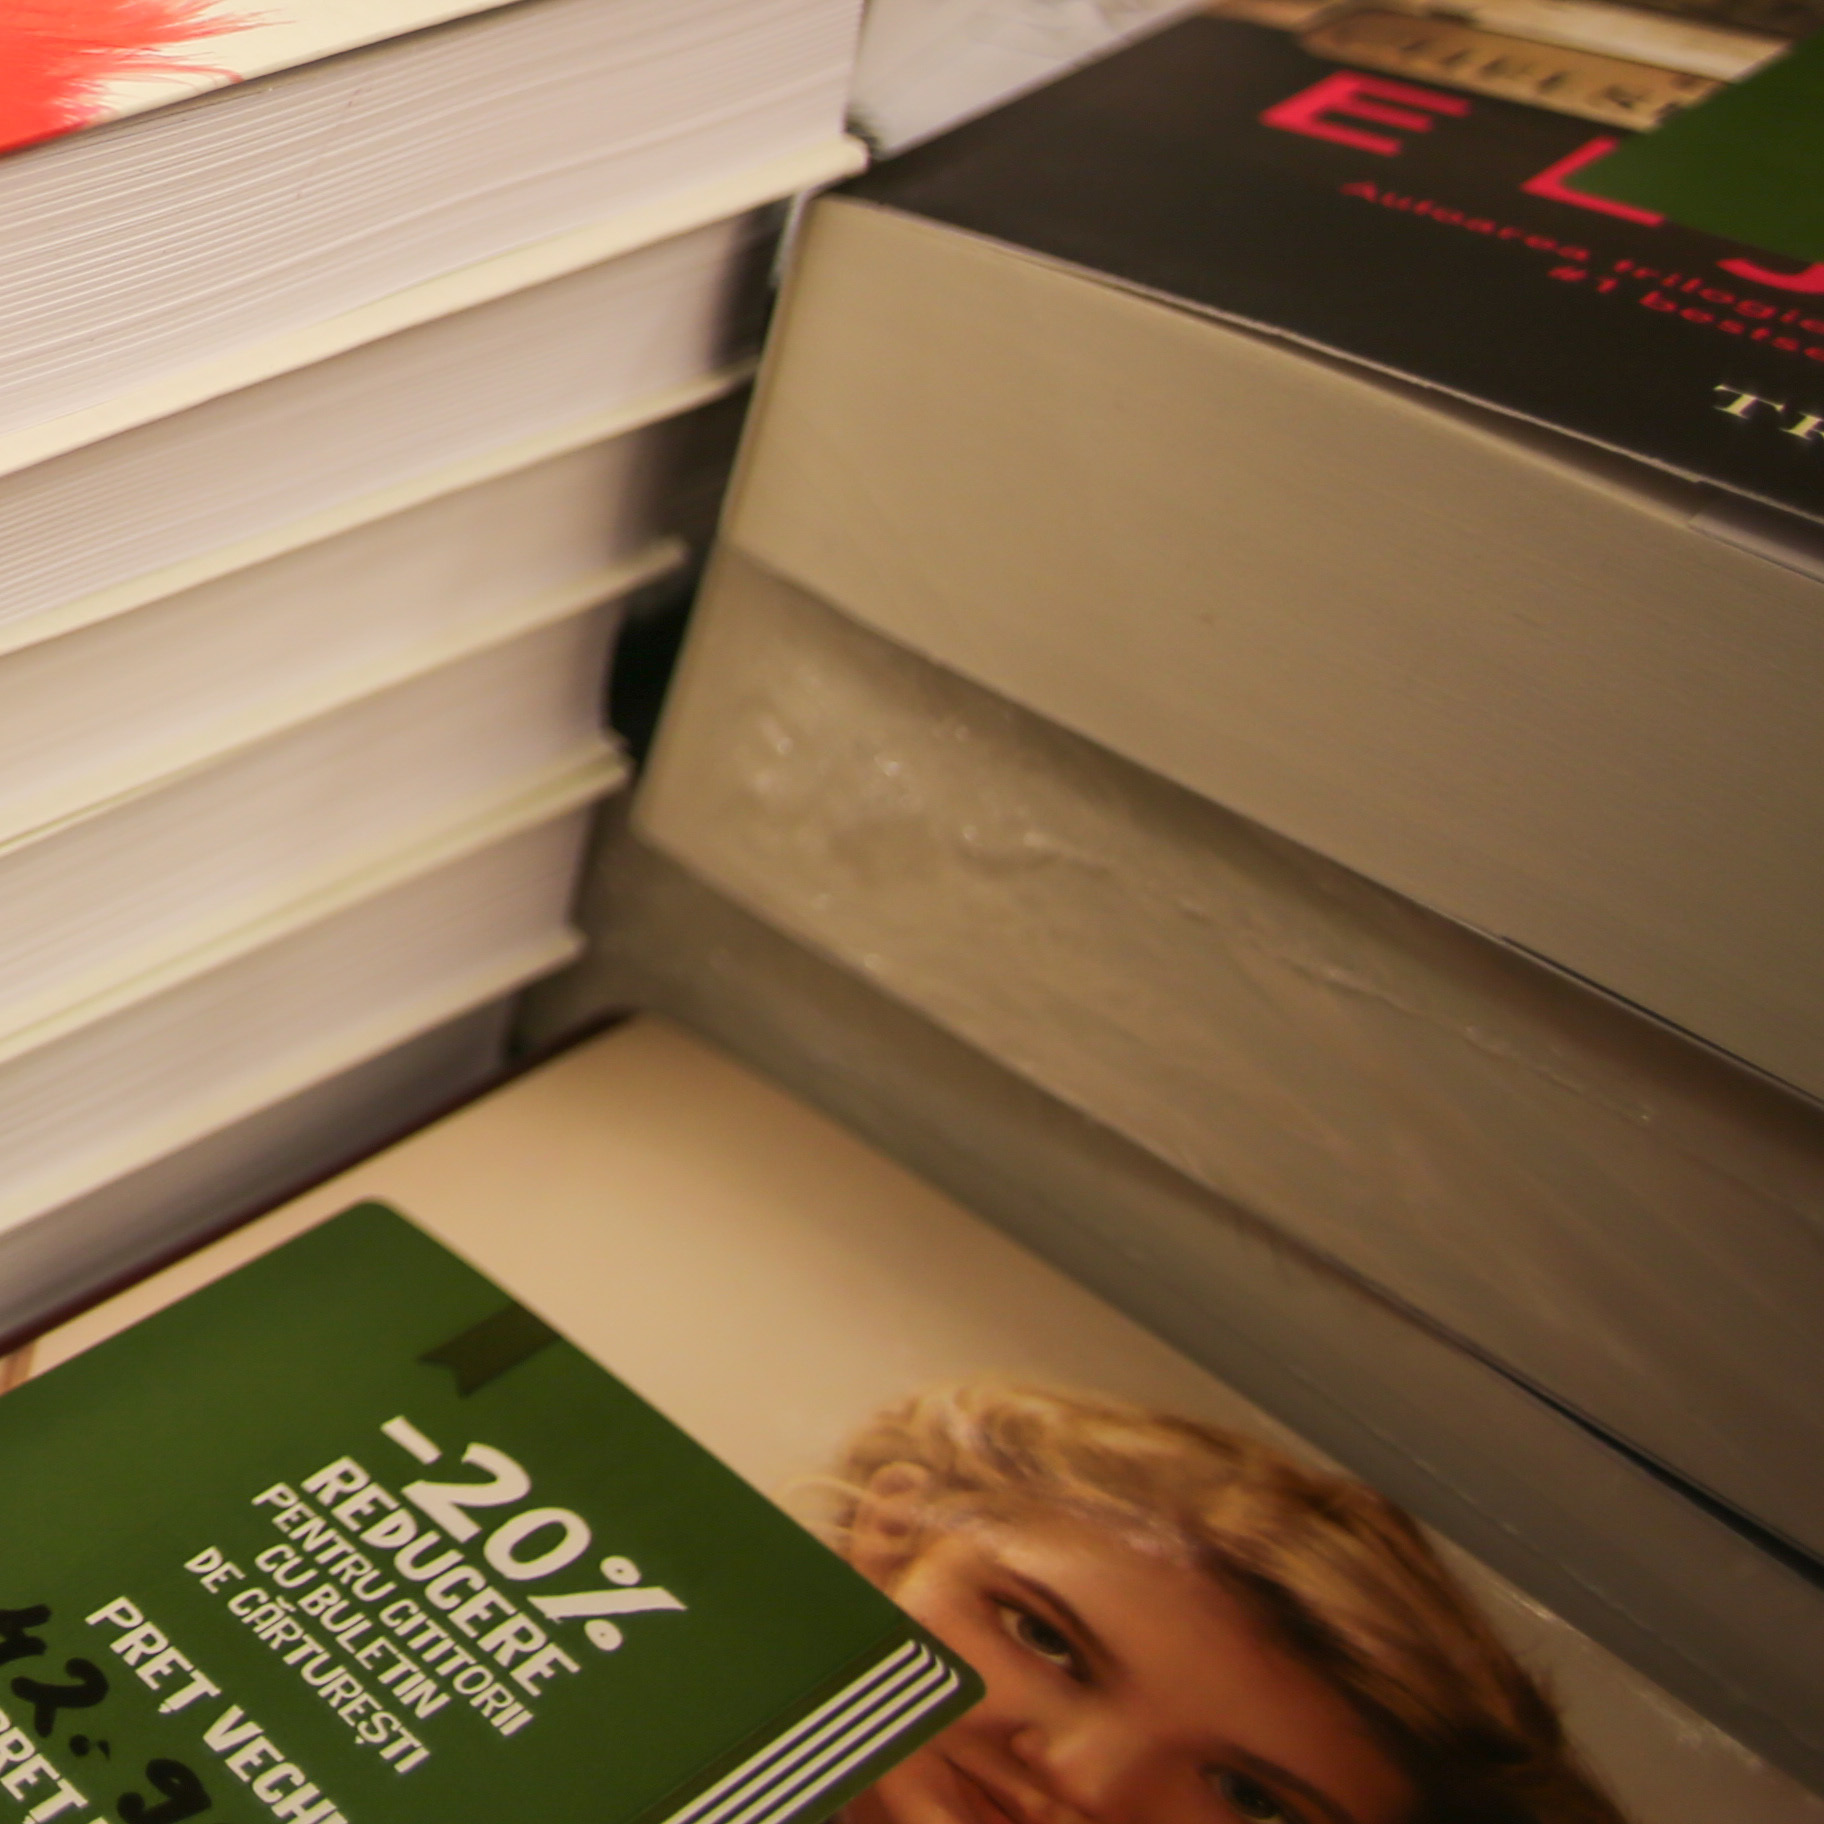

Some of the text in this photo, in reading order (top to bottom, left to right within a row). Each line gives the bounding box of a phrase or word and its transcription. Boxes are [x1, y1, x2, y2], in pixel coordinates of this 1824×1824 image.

[252, 1482, 535, 1737] PENTRU CITITORII
[255, 1542, 452, 1719] CU BULETIN
[301, 1456, 581, 1698] REDUCERE
[380, 1415, 688, 1652] -20%
[84, 1595, 222, 1714] PREȚ
[184, 1546, 431, 1774] DE CĂRTUREȘTI
